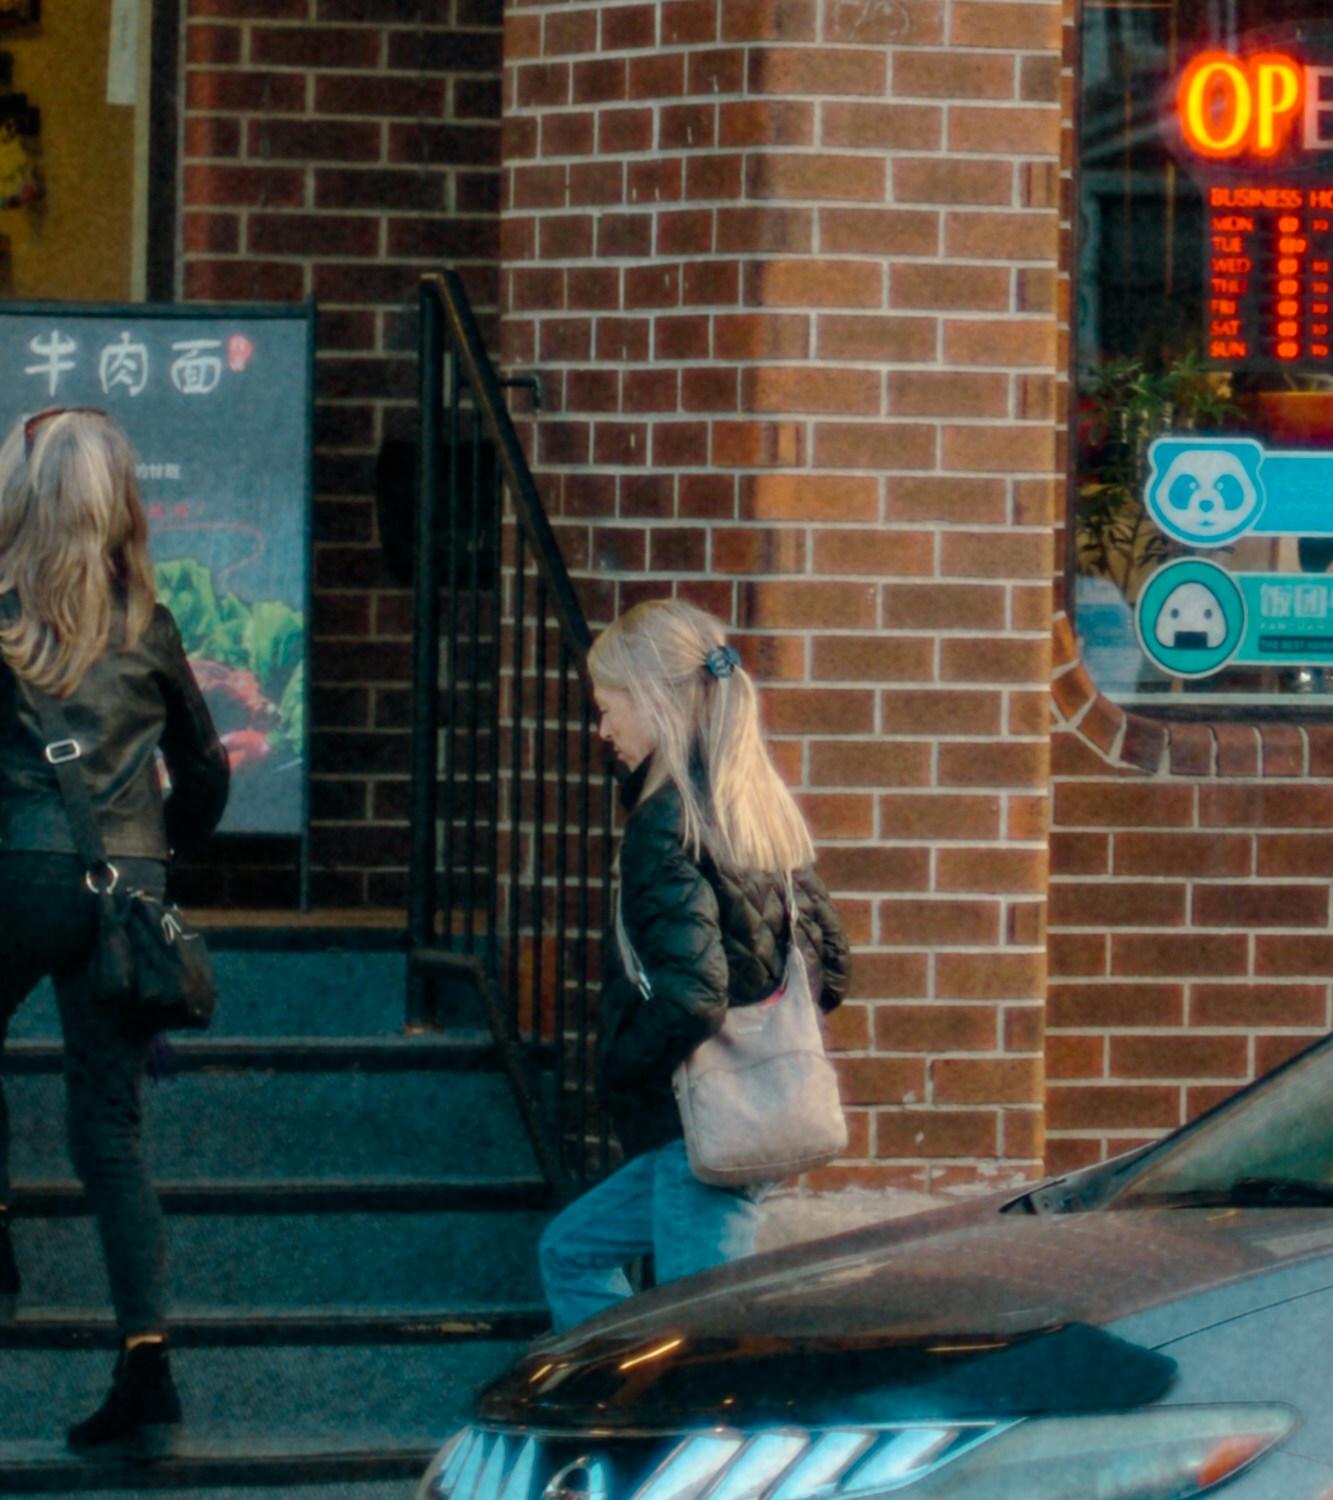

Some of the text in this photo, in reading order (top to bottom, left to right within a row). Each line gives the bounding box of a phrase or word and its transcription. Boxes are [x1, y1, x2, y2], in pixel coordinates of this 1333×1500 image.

[1210, 186, 1303, 209] BUSINESS
[1211, 215, 1254, 233] MON
[1211, 236, 1244, 254] TUE
[1211, 257, 1252, 274] WED
[1211, 277, 1248, 295] THU
[1210, 298, 1237, 316] FRI
[1210, 319, 1241, 337] SAT
[1210, 340, 1248, 359] SUN
[24, 328, 223, 398] 牛肉面
